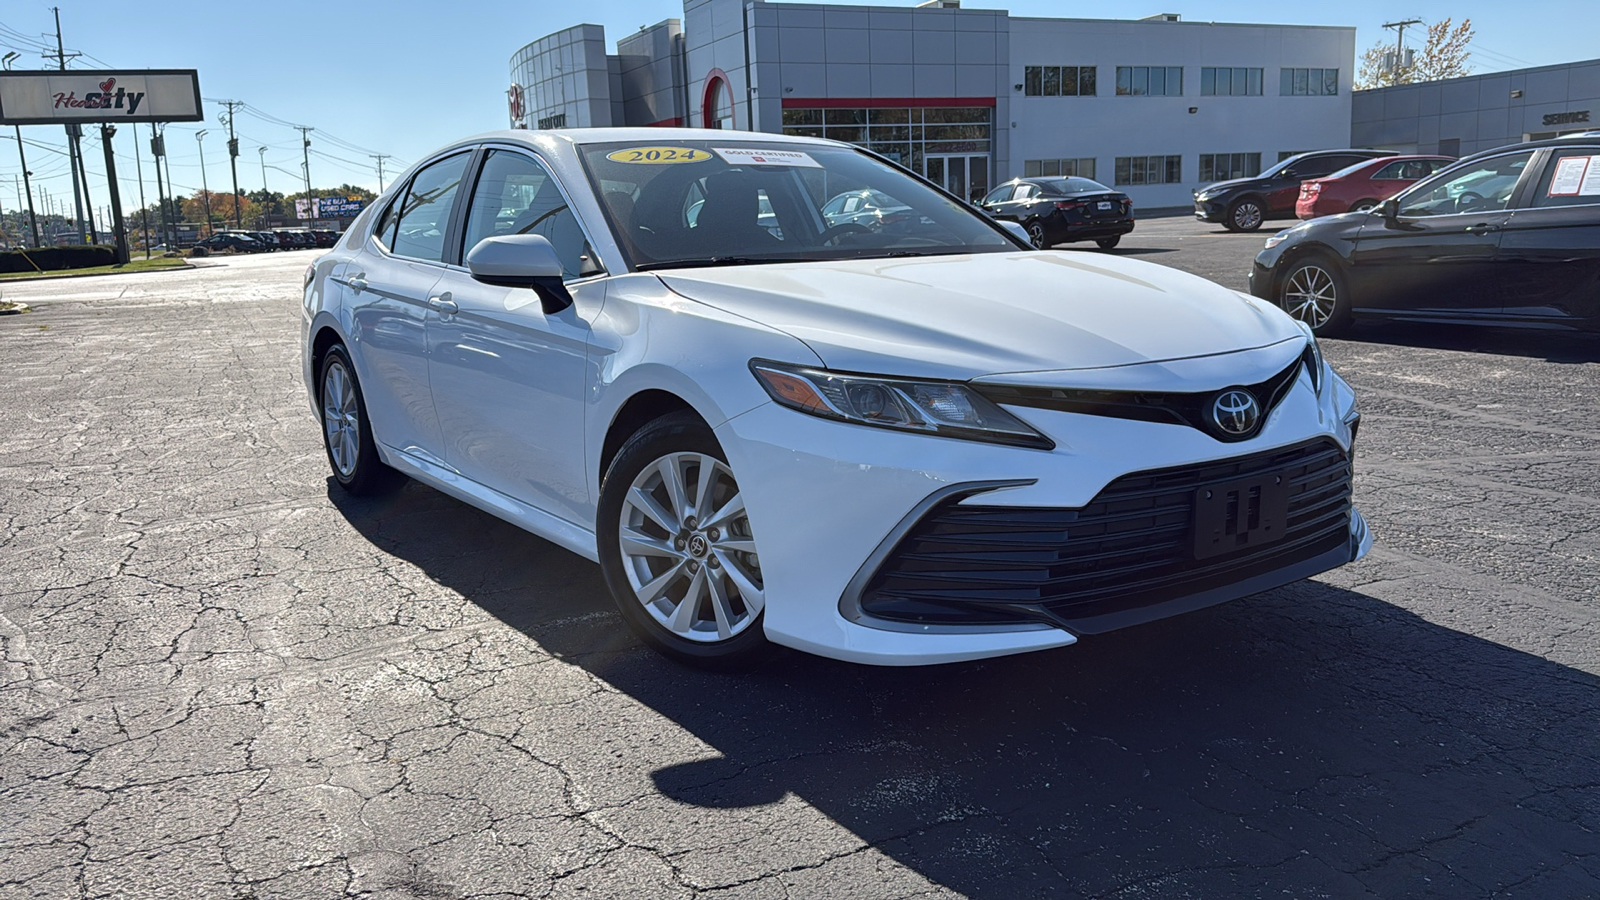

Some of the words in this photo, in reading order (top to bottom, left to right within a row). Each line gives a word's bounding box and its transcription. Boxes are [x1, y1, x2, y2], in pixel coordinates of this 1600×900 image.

[53, 91, 116, 109] Heart
[1542, 110, 1590, 125] SERVICE
[629, 149, 695, 162] 2024
